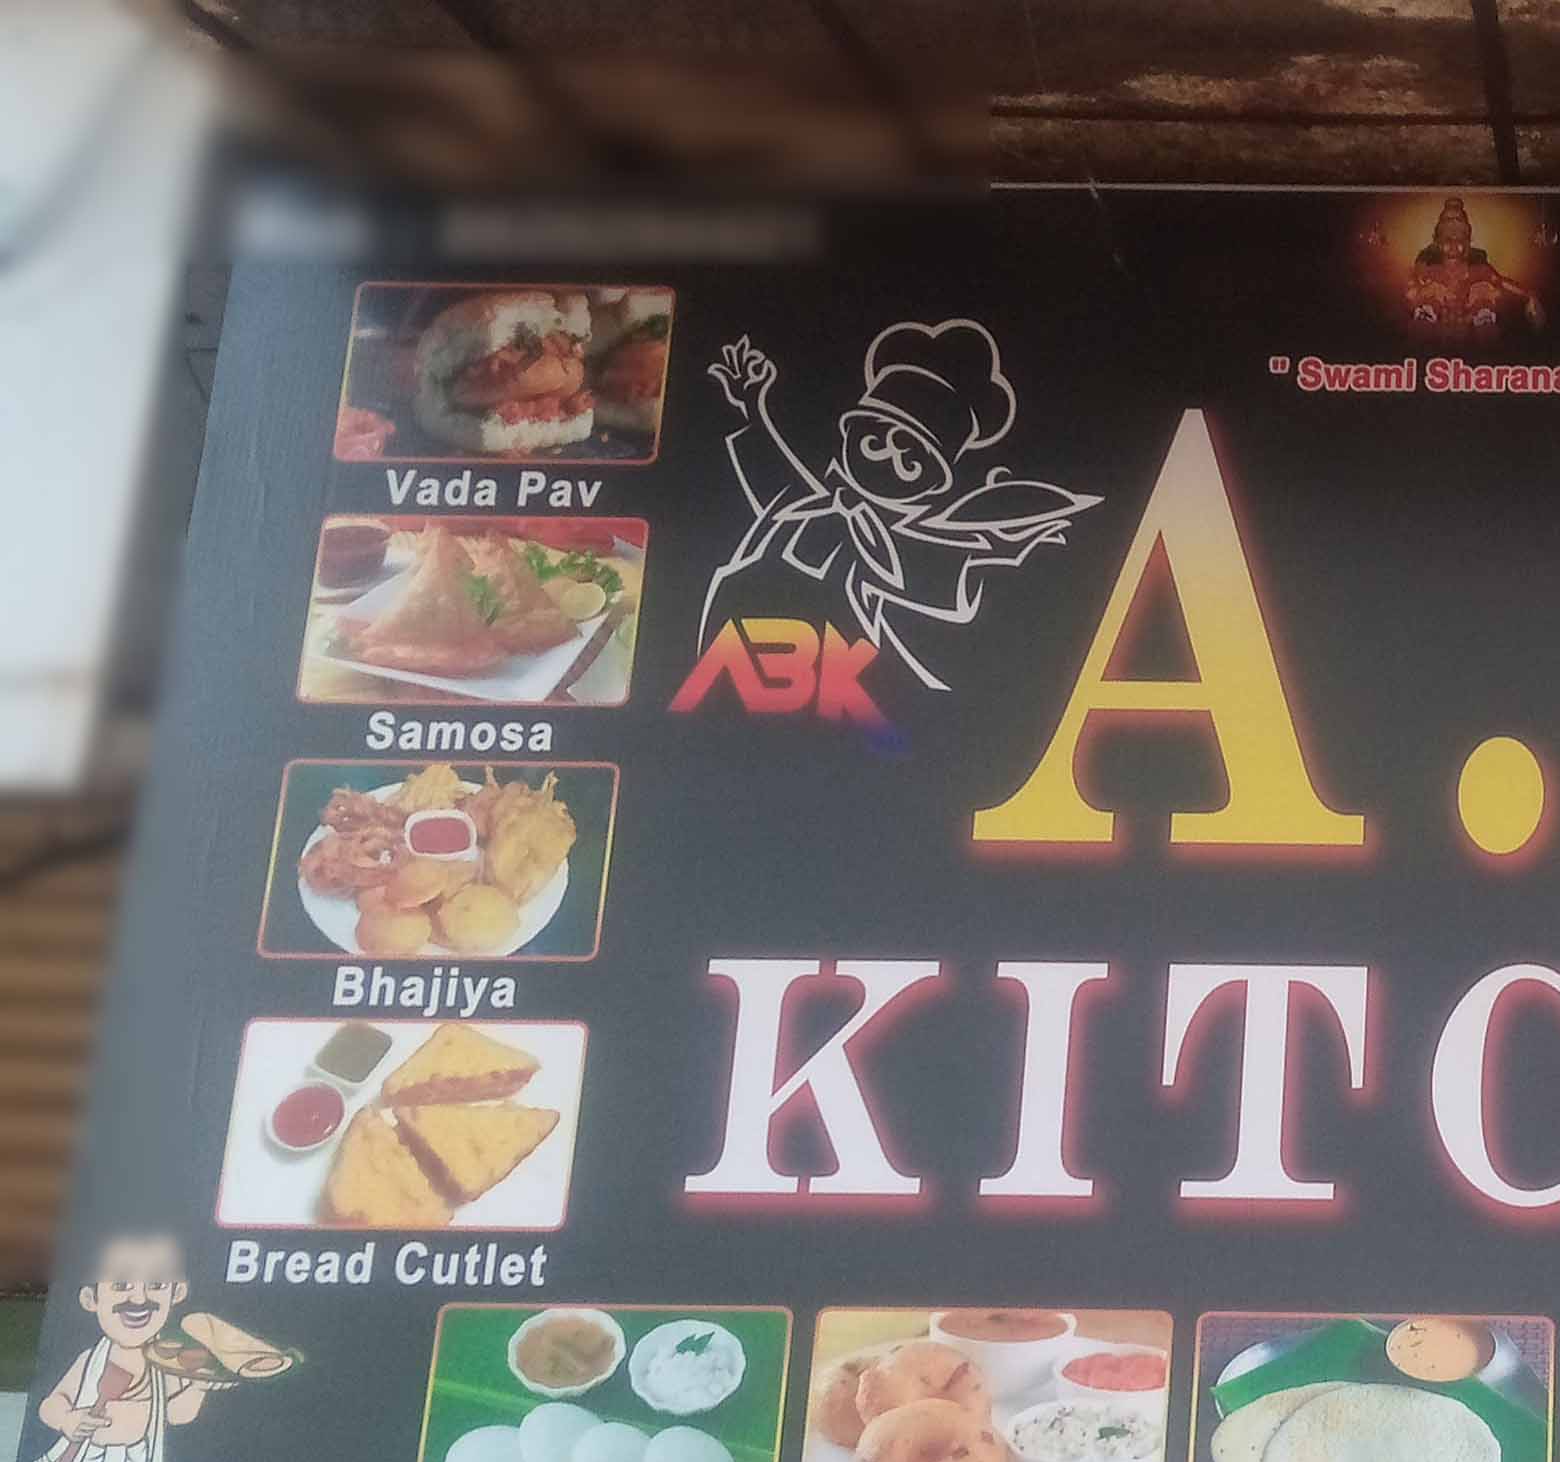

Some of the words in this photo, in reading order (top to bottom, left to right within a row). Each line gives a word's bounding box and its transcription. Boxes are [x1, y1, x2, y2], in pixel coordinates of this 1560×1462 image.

[1296, 355, 1418, 393] Swami
[386, 468, 497, 507] Vada
[517, 470, 603, 508] Pav
[366, 710, 553, 752] Samosa
[332, 965, 516, 1016] Bhajiya
[225, 1240, 376, 1284] Bread
[395, 1241, 548, 1286] Cutlet
